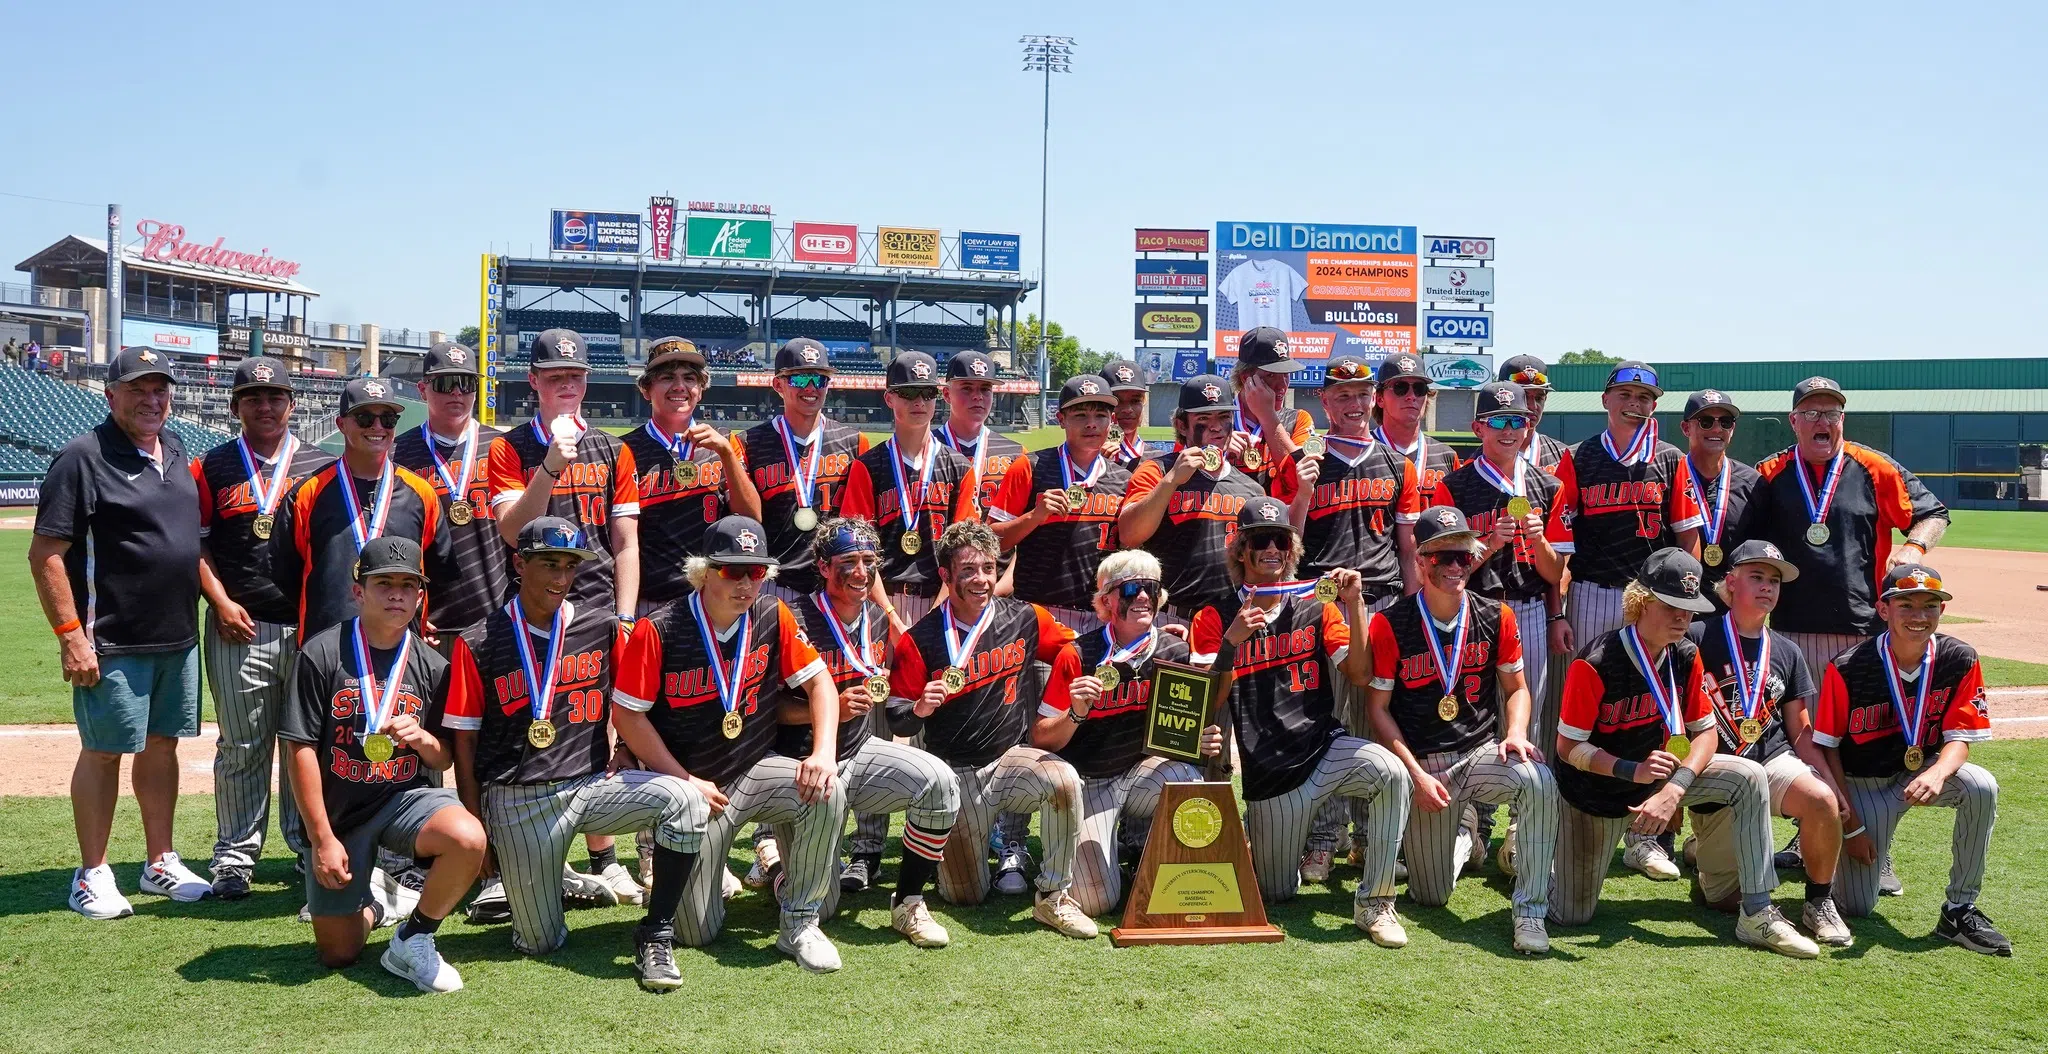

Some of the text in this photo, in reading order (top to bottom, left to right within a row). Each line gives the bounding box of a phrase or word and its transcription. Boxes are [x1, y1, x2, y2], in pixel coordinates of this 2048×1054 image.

[653, 198, 673, 206] Nyle
[688, 201, 771, 214] HOME RUN PORCH
[564, 227, 587, 235] PEPSI
[597, 228, 638, 236] EXPRESS
[655, 208, 670, 259] MAXWELL
[883, 232, 937, 243] GOLDEN
[1232, 224, 1402, 251] Dell Diamond
[597, 235, 638, 245] WATCHING
[888, 241, 929, 252] CHICK
[1139, 237, 1164, 245] TACO
[136, 219, 301, 278] Budweiser
[901, 253, 933, 261] ORIGINAL
[1331, 259, 1381, 267] CHAMPIONSHIPS
[1316, 267, 1409, 278] 2024 CHAMPIONS
[1141, 275, 1203, 286] MIGHTY FINE
[1312, 285, 1412, 298] CONGRATULATIONS
[1455, 288, 1490, 298] Heritage
[1353, 302, 1370, 311] IRA
[1151, 314, 1194, 323] Chicken
[1325, 311, 1398, 323] BULLDOGS!
[1430, 319, 1485, 336] GOYA
[231, 329, 308, 346] BE GARDEN
[486, 268, 498, 408] CODY POOLS
[1305, 337, 1330, 345] STATE
[1346, 337, 1383, 345] PEPWEAR
[1299, 345, 1326, 353] TODAY!
[578, 494, 606, 526] 10
[703, 494, 719, 524] 8
[1369, 508, 1385, 536] 4
[1636, 511, 1662, 539] 15
[1233, 625, 1316, 668] ULLDOGS
[1287, 660, 1320, 693] 13
[1003, 676, 1019, 706] 9
[1463, 675, 1482, 703] 2
[567, 689, 604, 724] 30
[744, 684, 761, 716] 5
[1157, 712, 1197, 732] MVP
[331, 746, 419, 784] BOUND
